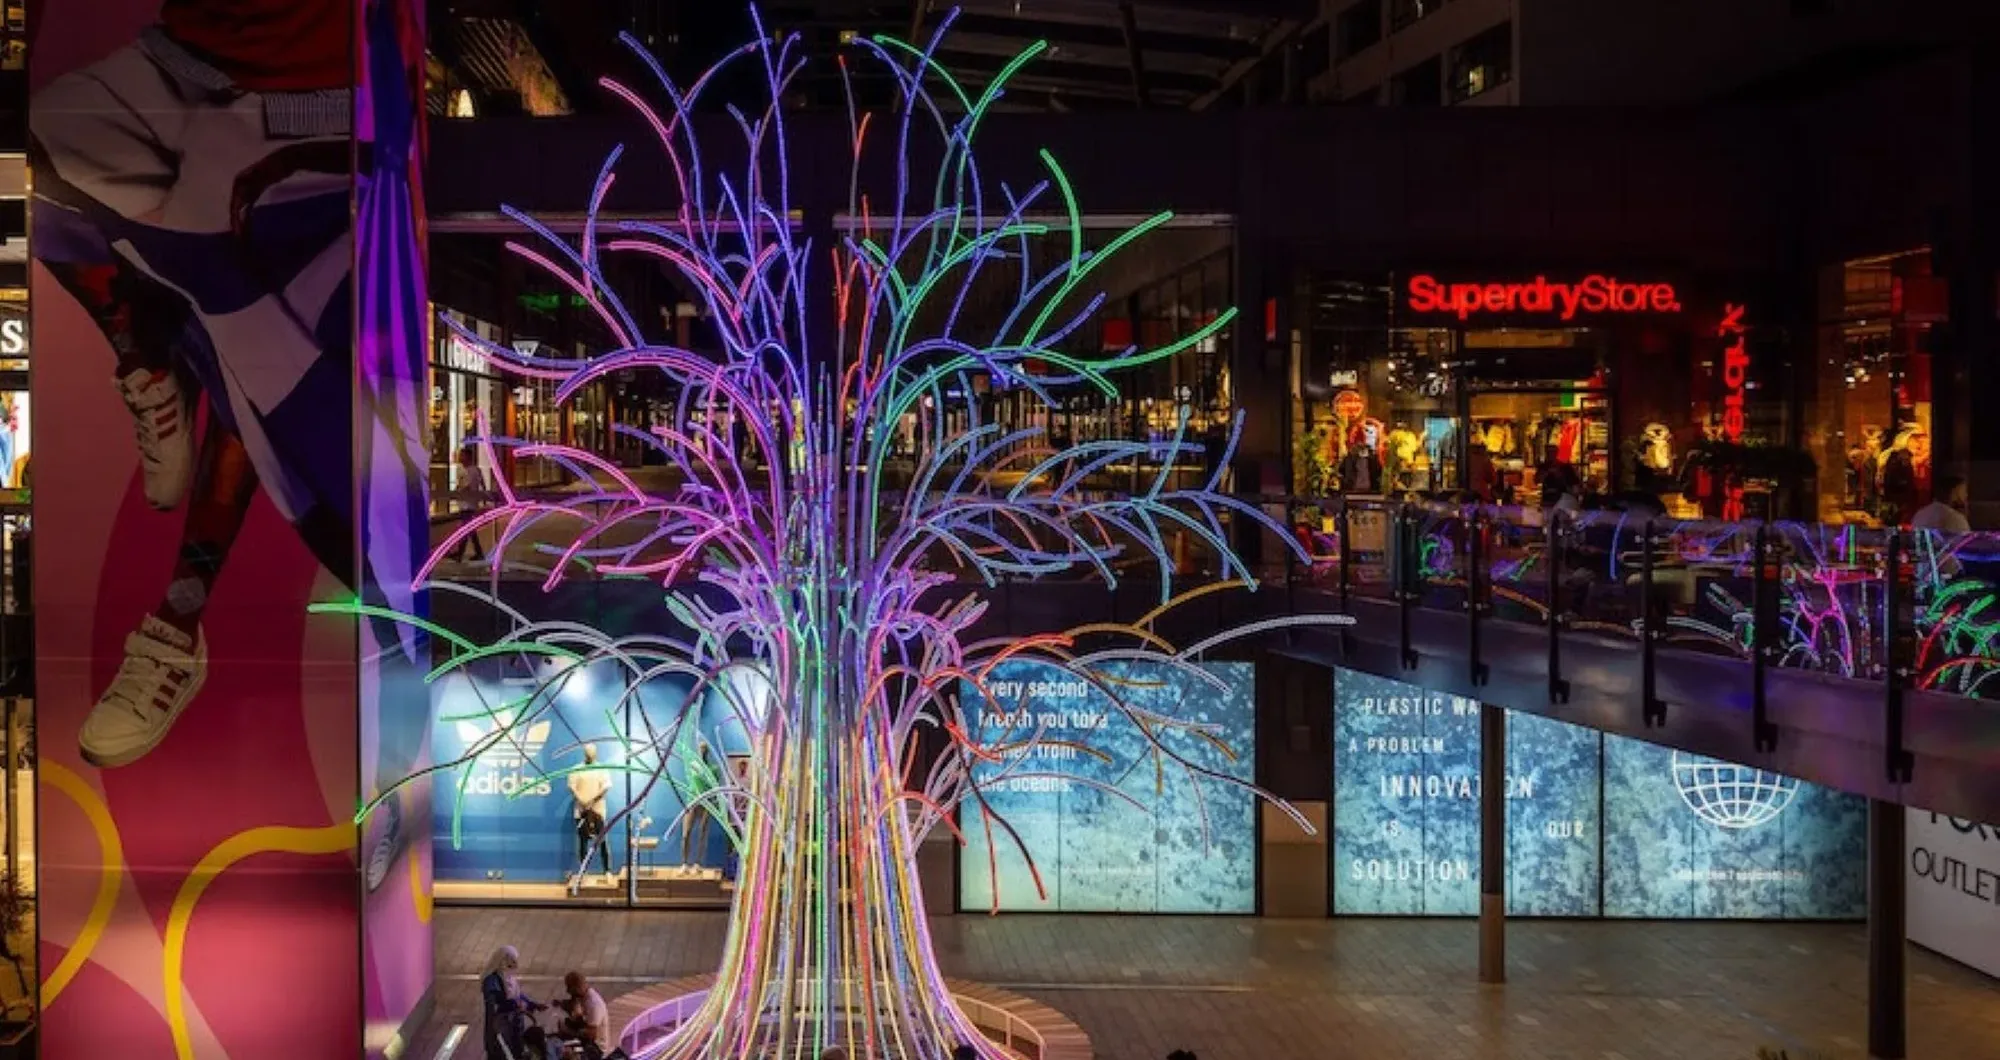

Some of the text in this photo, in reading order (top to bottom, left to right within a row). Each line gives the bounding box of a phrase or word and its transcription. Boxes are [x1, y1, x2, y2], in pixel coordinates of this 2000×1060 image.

[1409, 275, 1681, 320] SuperdryStore.
[1028, 681, 1088, 697] second
[1364, 698, 1443, 716] PLASTIC
[1038, 713, 1067, 731] you
[1349, 737, 1444, 753] A PROBLEM
[456, 770, 552, 795] adidas
[1380, 775, 1533, 798] INNOVATON
[1385, 820, 1585, 838] IS OUR
[1352, 859, 1469, 880] SOLUTION
